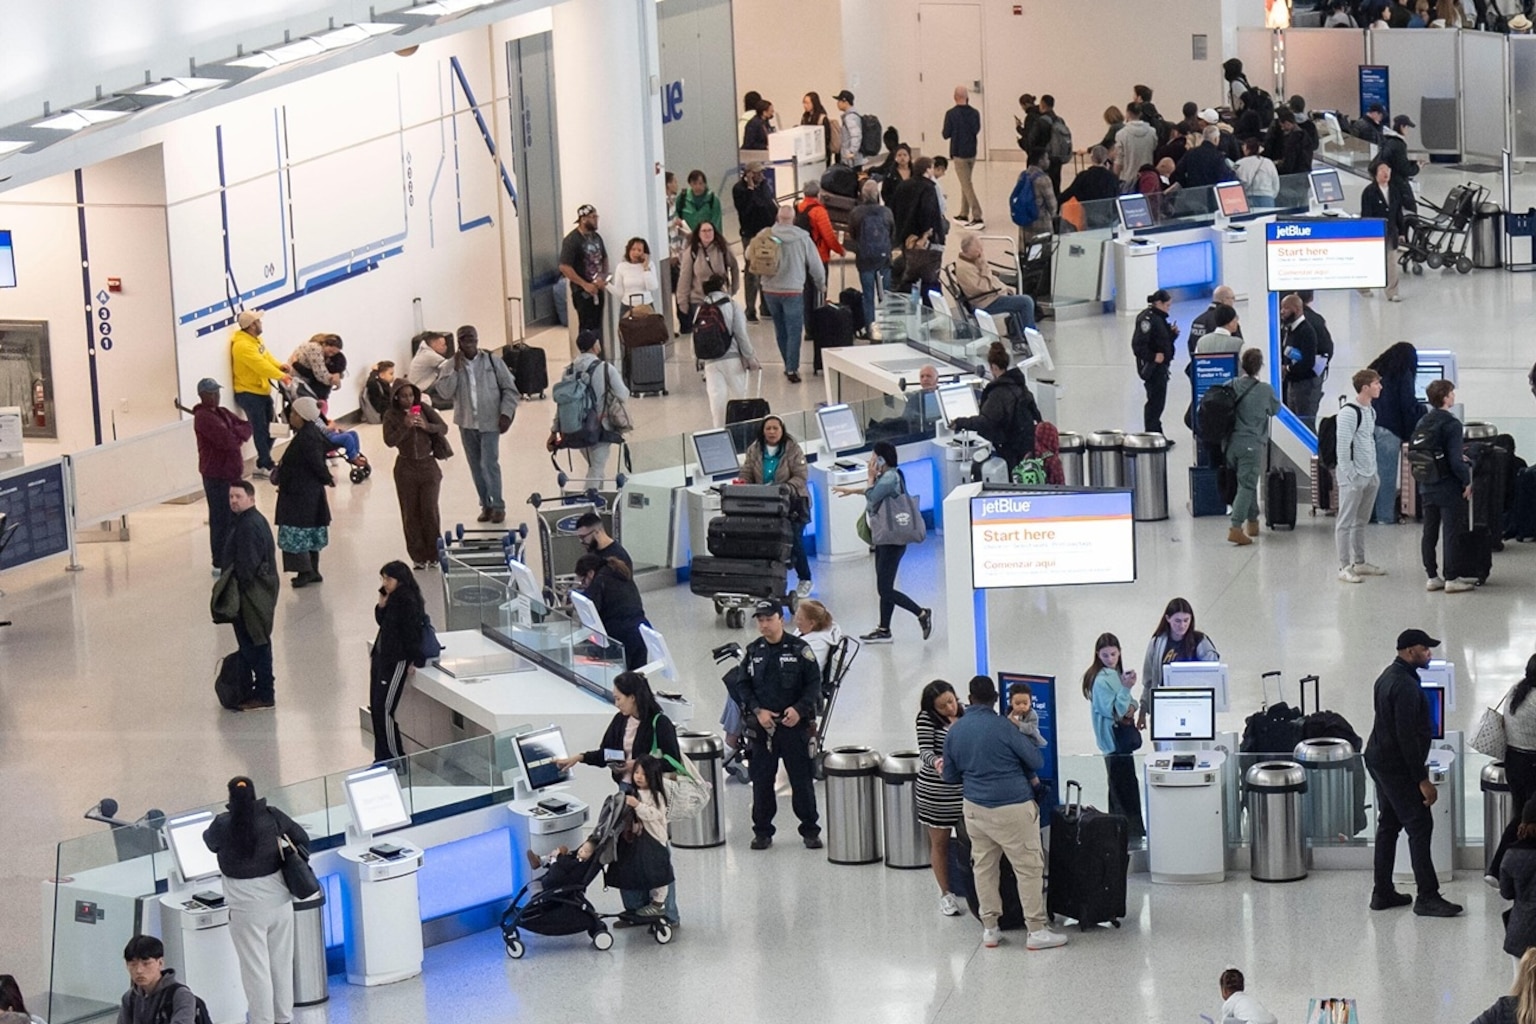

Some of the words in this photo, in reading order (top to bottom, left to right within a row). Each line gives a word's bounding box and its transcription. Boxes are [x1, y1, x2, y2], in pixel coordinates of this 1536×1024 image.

[1276, 225, 1312, 239] jetBlue
[1278, 247, 1304, 257] Start
[1306, 246, 1328, 256] here
[982, 499, 1031, 516] jetBlue
[984, 530, 1020, 542] Start
[1024, 528, 1055, 541] here
[984, 560, 1033, 570] Comenzar
